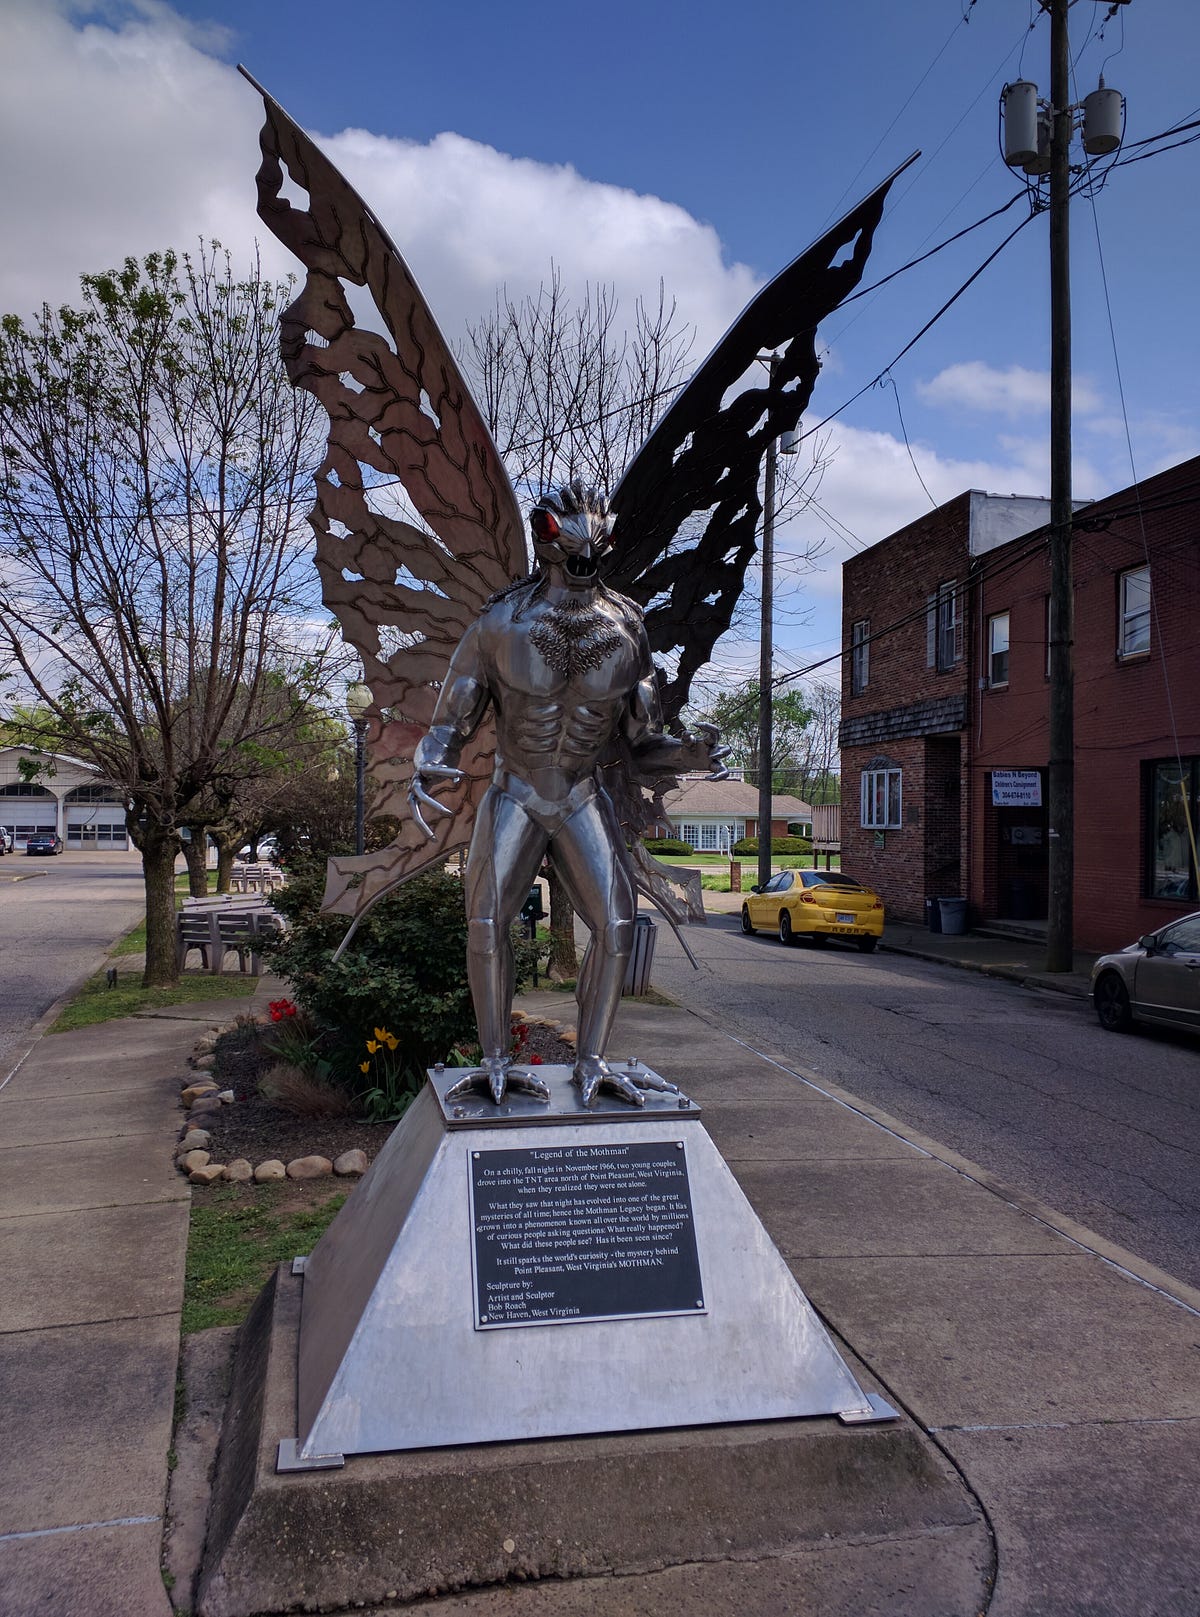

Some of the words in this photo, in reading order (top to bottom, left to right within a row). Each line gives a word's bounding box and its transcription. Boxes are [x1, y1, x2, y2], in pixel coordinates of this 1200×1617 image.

[530, 1150, 563, 1160] "Legend
[565, 1148, 574, 1157] of
[576, 1148, 588, 1157] the
[590, 1146, 630, 1156] Mothman"
[484, 1168, 494, 1176] On
[502, 1167, 524, 1176] chilly,
[524, 1166, 536, 1174] fall
[537, 1166, 554, 1175] night
[565, 1162, 598, 1172] November
[600, 1162, 616, 1170] 1966,
[631, 1162, 651, 1170] young
[652, 1160, 676, 1169] couples
[560, 1174, 578, 1182] north
[608, 1172, 637, 1180] Pleasant,
[637, 1170, 653, 1178] West
[654, 1169, 684, 1178] Virginia,
[518, 1186, 536, 1194] when
[538, 1185, 552, 1194] they
[555, 1184, 582, 1192] realized
[584, 1183, 598, 1192] they
[489, 1202, 508, 1210] What
[509, 1201, 523, 1210] they
[540, 1200, 554, 1208] that
[555, 1199, 572, 1208] night
[574, 1198, 586, 1206] has
[586, 1197, 611, 1205] evolved
[661, 1194, 679, 1202] great
[480, 1212, 513, 1222] mysteries
[514, 1211, 522, 1219] of
[523, 1210, 532, 1219] all
[552, 1209, 571, 1217] hence
[573, 1208, 584, 1216] the
[586, 1206, 617, 1215] Mothman
[620, 1206, 643, 1214] Legacy
[478, 1224, 500, 1233] grown
[502, 1222, 517, 1230] into
[524, 1220, 566, 1229] phenomenon
[568, 1218, 592, 1226] known
[631, 1214, 650, 1222] world
[651, 1213, 660, 1222] by
[661, 1212, 689, 1220] millions
[496, 1232, 522, 1240] curious
[524, 1230, 546, 1240] people
[548, 1229, 571, 1237] asking
[607, 1225, 626, 1233] What
[626, 1224, 646, 1233] really
[648, 1222, 684, 1232] happened?
[522, 1241, 533, 1249] did
[554, 1239, 576, 1248] people
[596, 1236, 609, 1244] Has
[496, 1258, 502, 1266] It
[503, 1257, 517, 1265] still
[518, 1256, 540, 1265] sparks
[578, 1252, 609, 1260] curiosity
[614, 1250, 625, 1258] the
[627, 1249, 654, 1258] mystery
[655, 1247, 679, 1255] behind
[514, 1267, 532, 1275] Point
[534, 1266, 565, 1274] Pleasant,
[583, 1261, 617, 1271] Virginia's
[486, 1282, 521, 1291] Sculpture
[522, 1281, 533, 1289] by:
[488, 1294, 510, 1303] Artist
[525, 1291, 555, 1300] Sculptor
[488, 1303, 503, 1312] Bob
[505, 1302, 527, 1310] Roach
[488, 1312, 504, 1320] New
[506, 1311, 531, 1319] Haven,
[531, 1309, 548, 1317] West
[550, 1307, 580, 1317] Virginia
